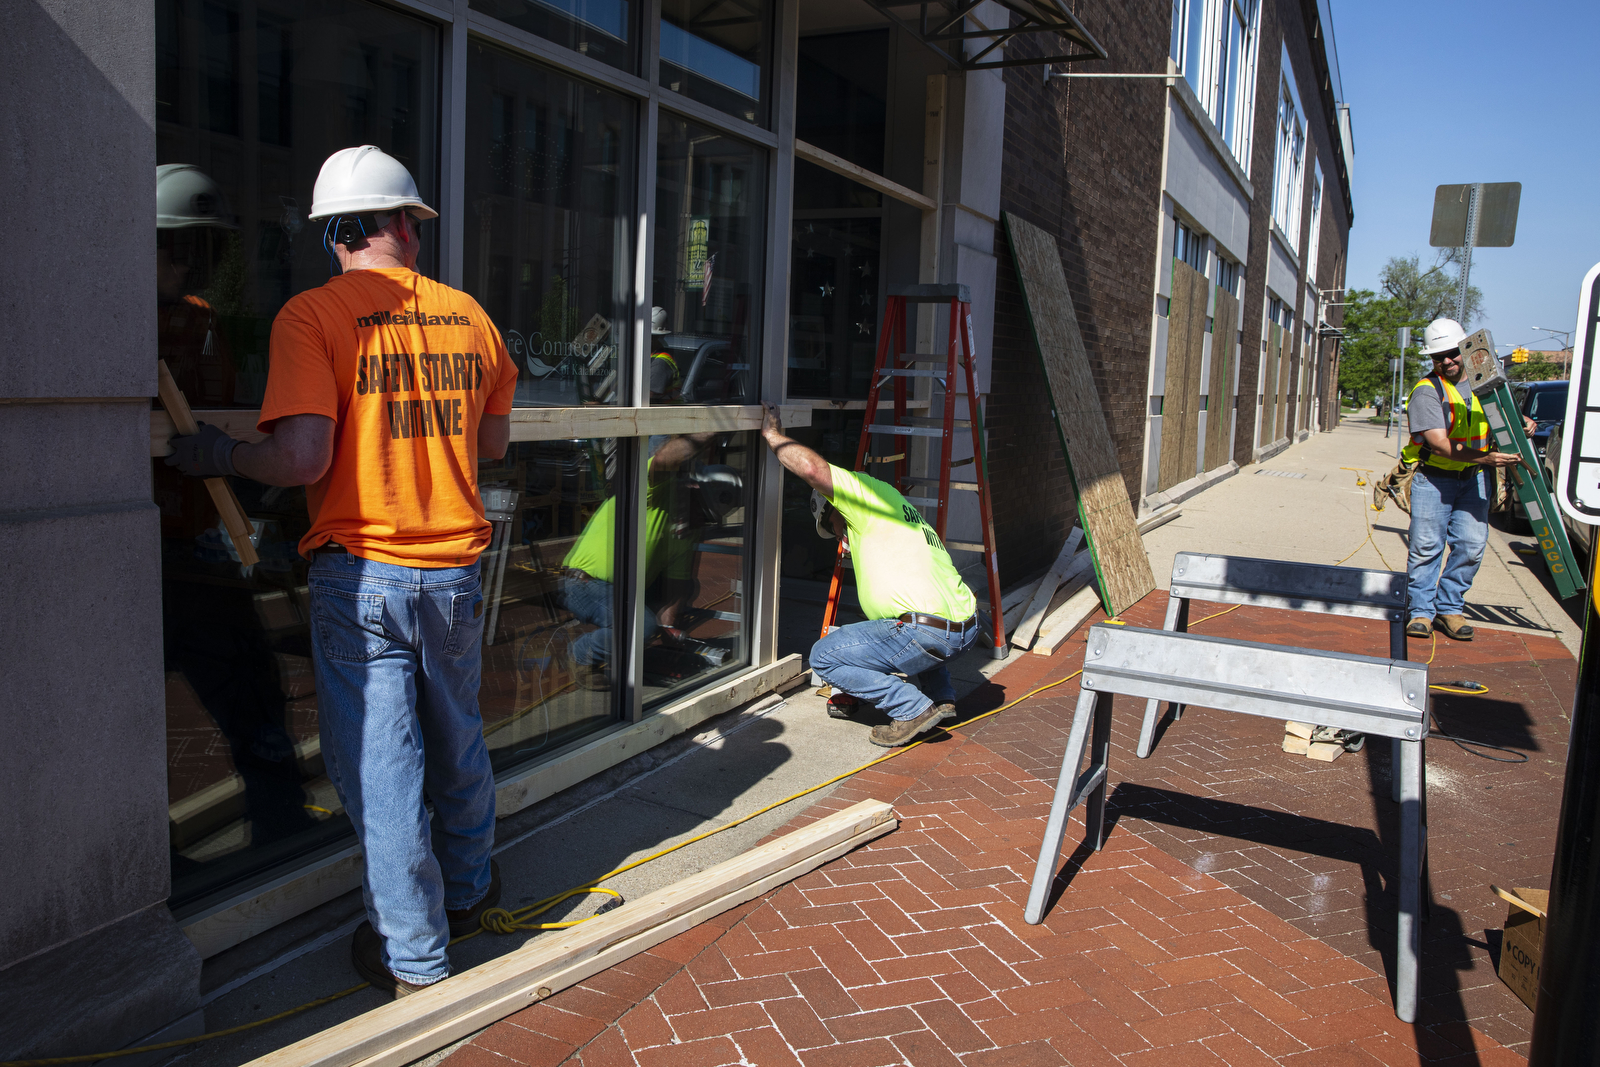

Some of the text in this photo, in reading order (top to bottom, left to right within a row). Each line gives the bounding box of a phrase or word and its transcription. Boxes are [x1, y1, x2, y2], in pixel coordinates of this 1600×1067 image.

[506, 338, 523, 355] re
[418, 352, 483, 393] STARTS
[1511, 944, 1537, 976] COPY
